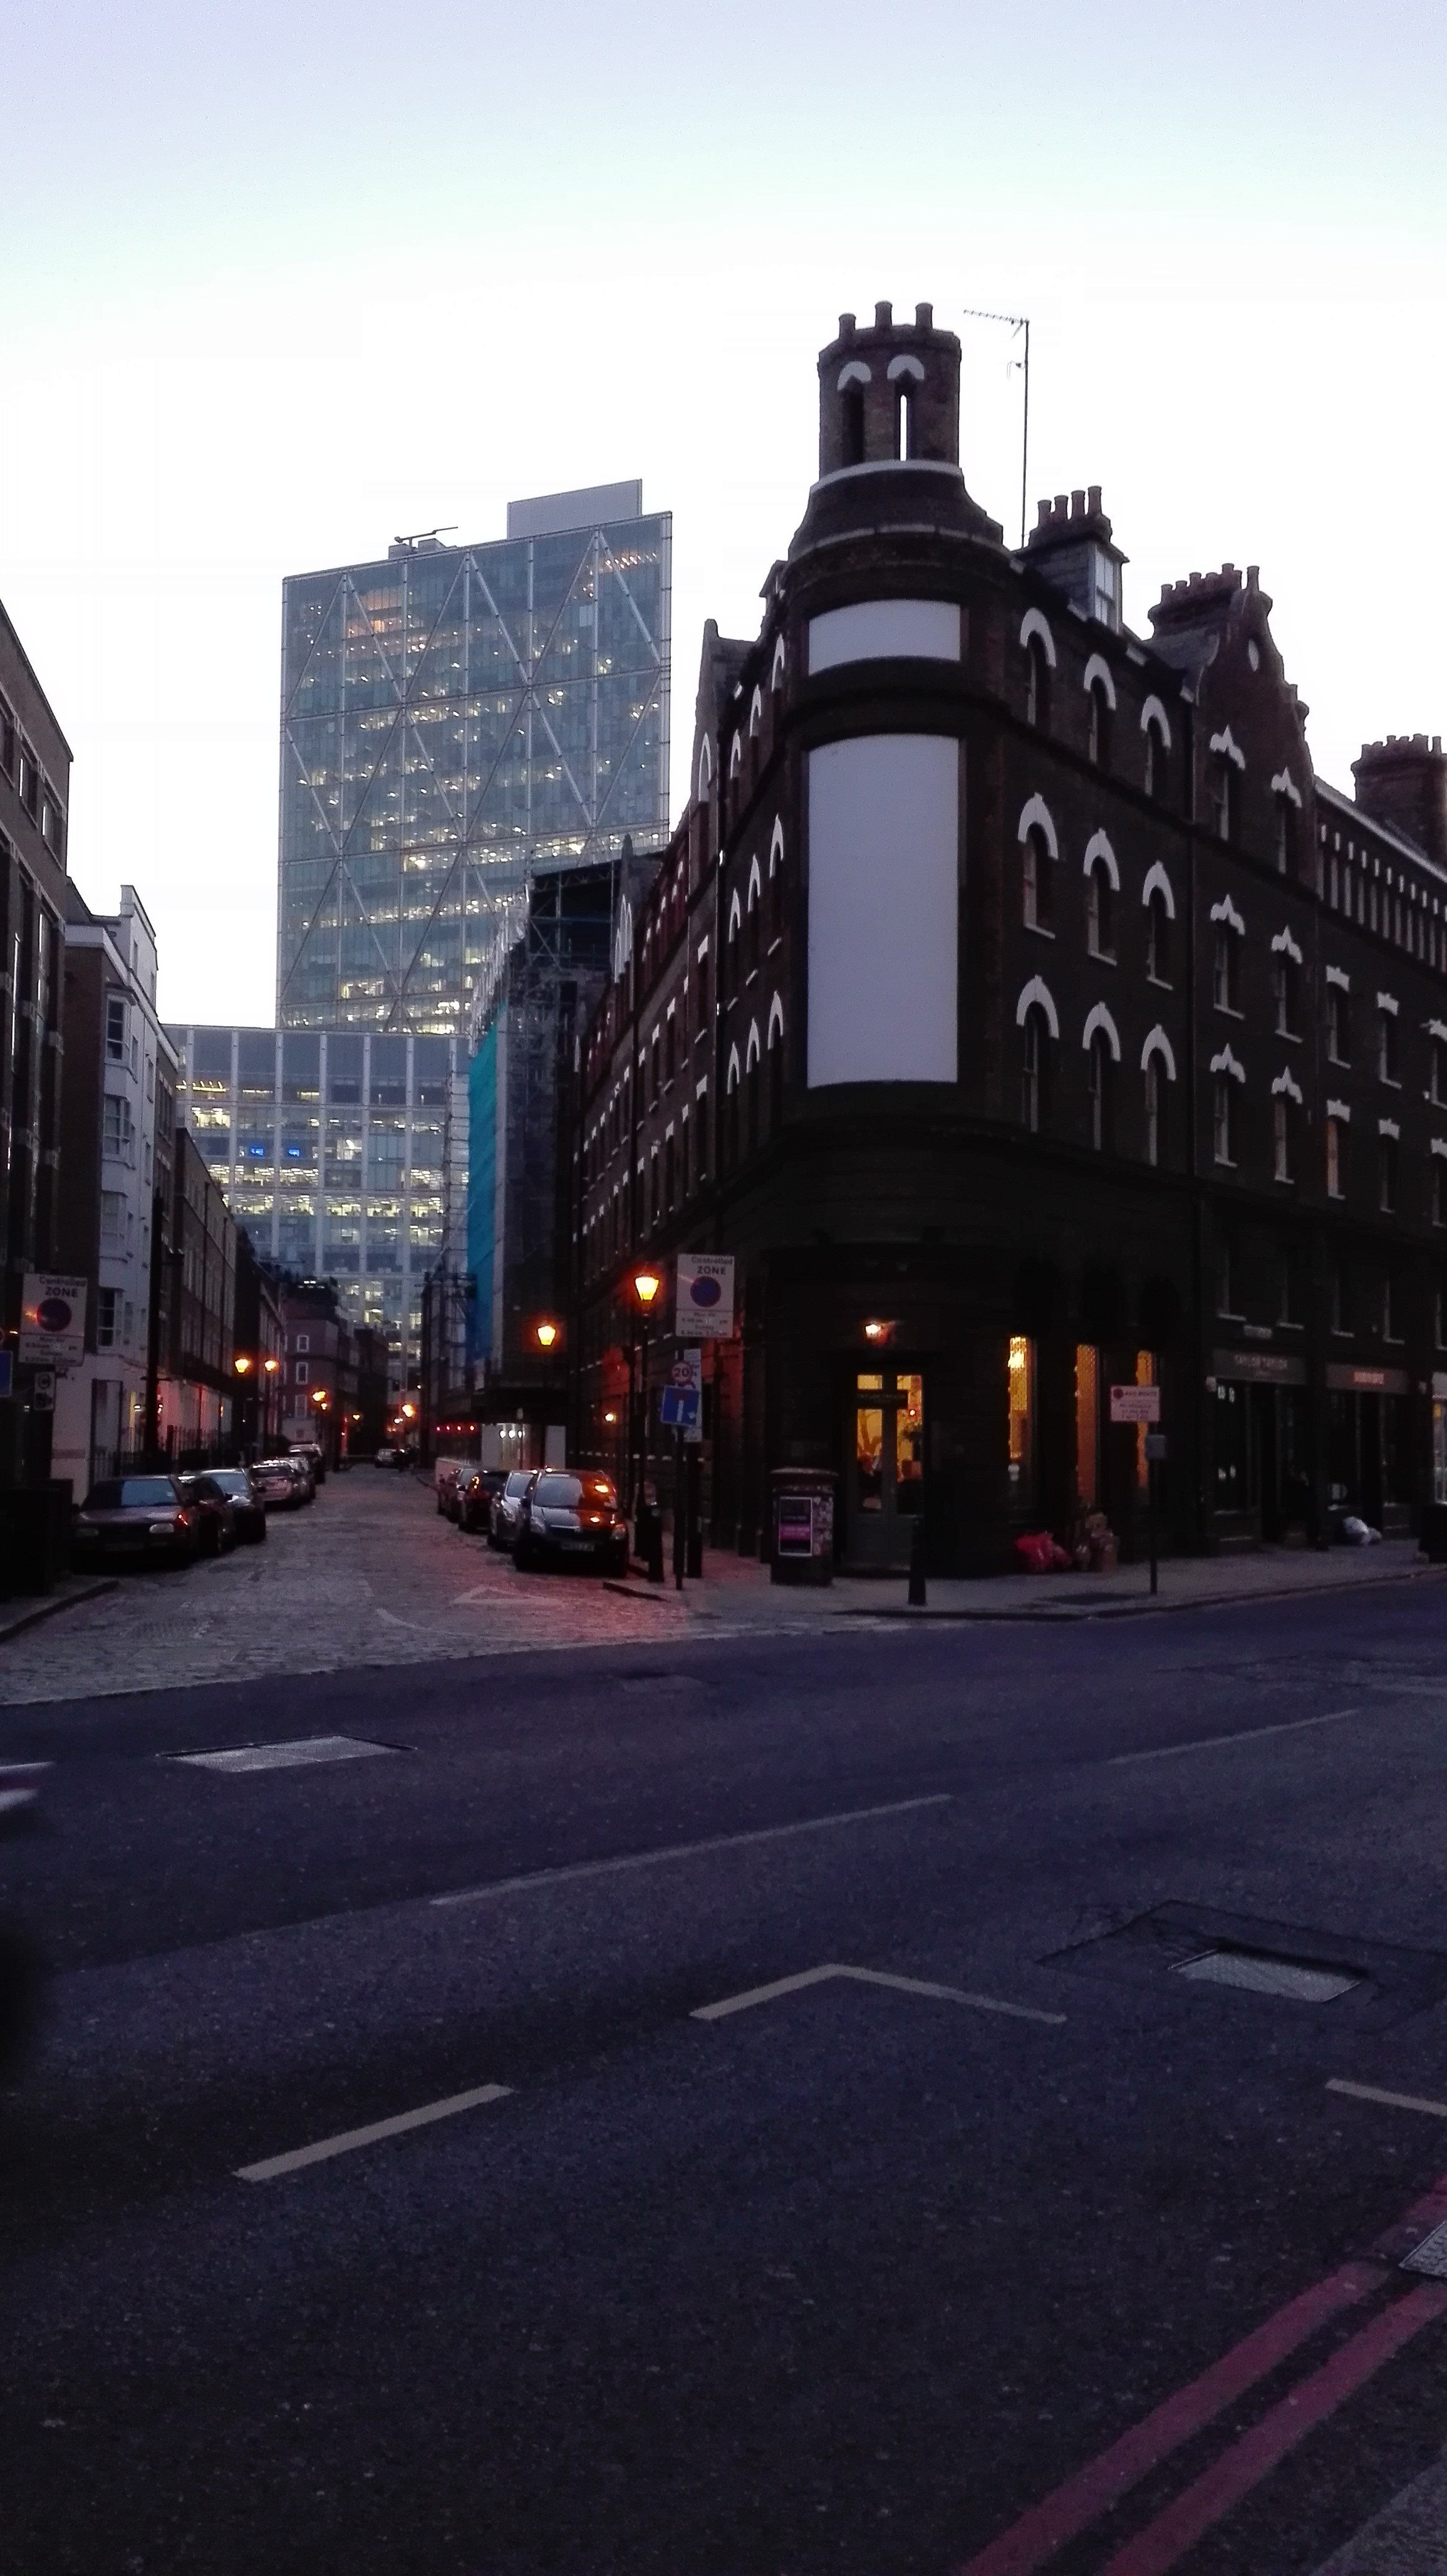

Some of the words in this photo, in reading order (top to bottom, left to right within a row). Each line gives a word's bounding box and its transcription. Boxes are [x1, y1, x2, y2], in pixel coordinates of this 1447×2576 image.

[697, 1266, 726, 1275] ZONE
[45, 1286, 78, 1297] ZONE
[674, 1367, 689, 1377] 20
